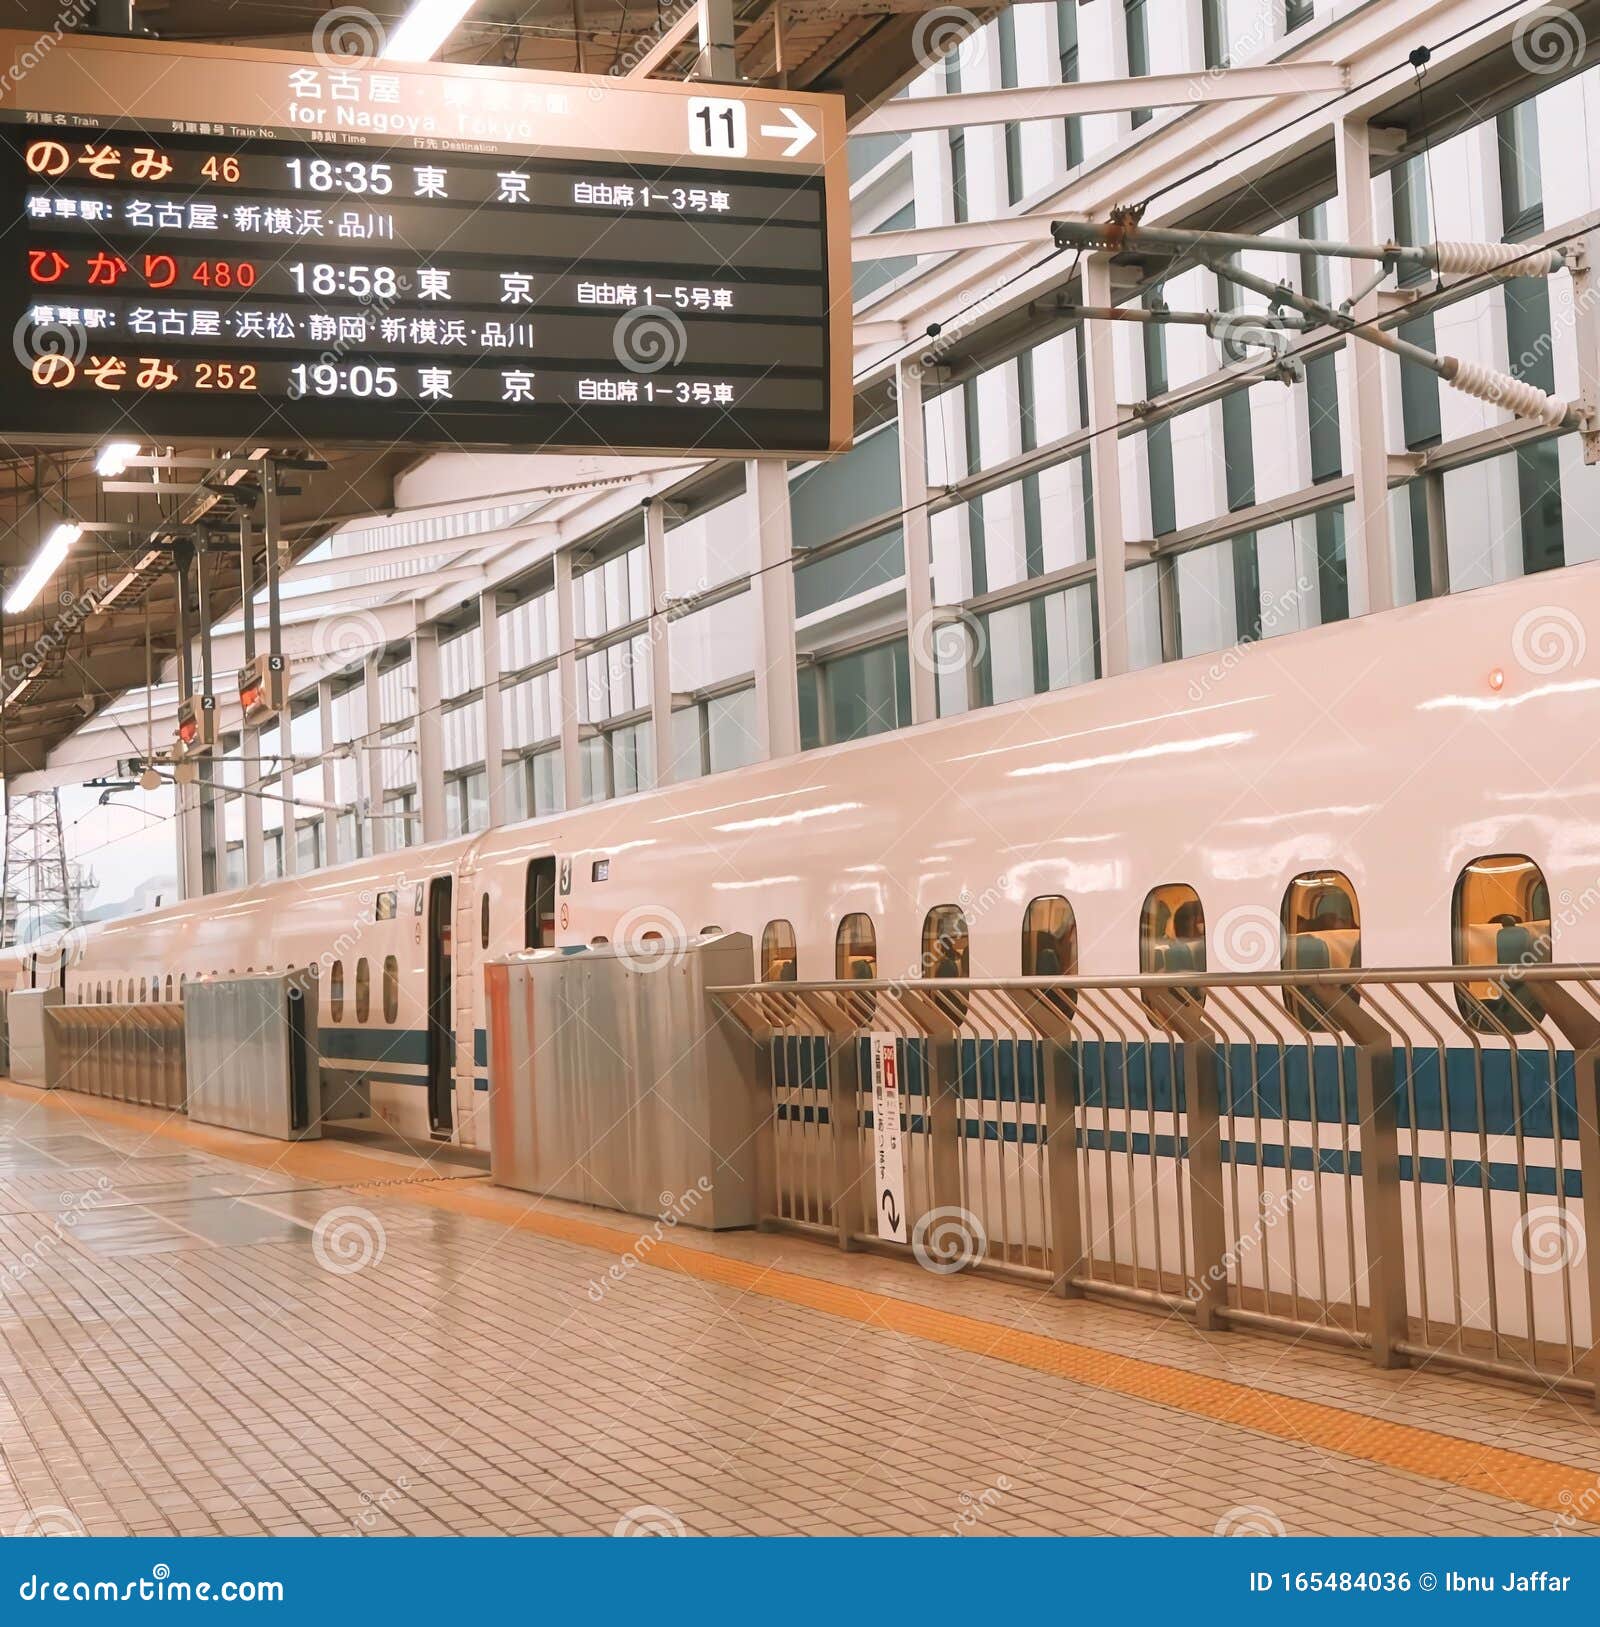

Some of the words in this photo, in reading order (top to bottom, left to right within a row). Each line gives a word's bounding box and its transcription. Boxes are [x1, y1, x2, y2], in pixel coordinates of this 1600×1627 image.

[26, 111, 67, 126] 列車名
[71, 115, 99, 127] Train
[289, 102, 326, 123] for
[172, 121, 225, 136] 列車番号
[230, 126, 256, 138] Train
[259, 128, 277, 138] No.
[695, 106, 735, 149] 11
[341, 133, 367, 144] Time
[413, 137, 438, 150] 行先
[442, 140, 498, 153] Destination
[25, 141, 174, 181] のぞみ
[201, 156, 240, 183] 46
[286, 158, 393, 196] 18:35
[28, 251, 178, 288] ひかり
[192, 261, 256, 287] 480
[290, 262, 397, 298] 18:58
[32, 353, 179, 391] のぞみ
[195, 363, 257, 390] 252
[291, 363, 398, 398] 19:05
[271, 657, 282, 670] 3
[204, 698, 213, 709] 2
[561, 860, 570, 892] 3
[415, 884, 423, 913] 2
